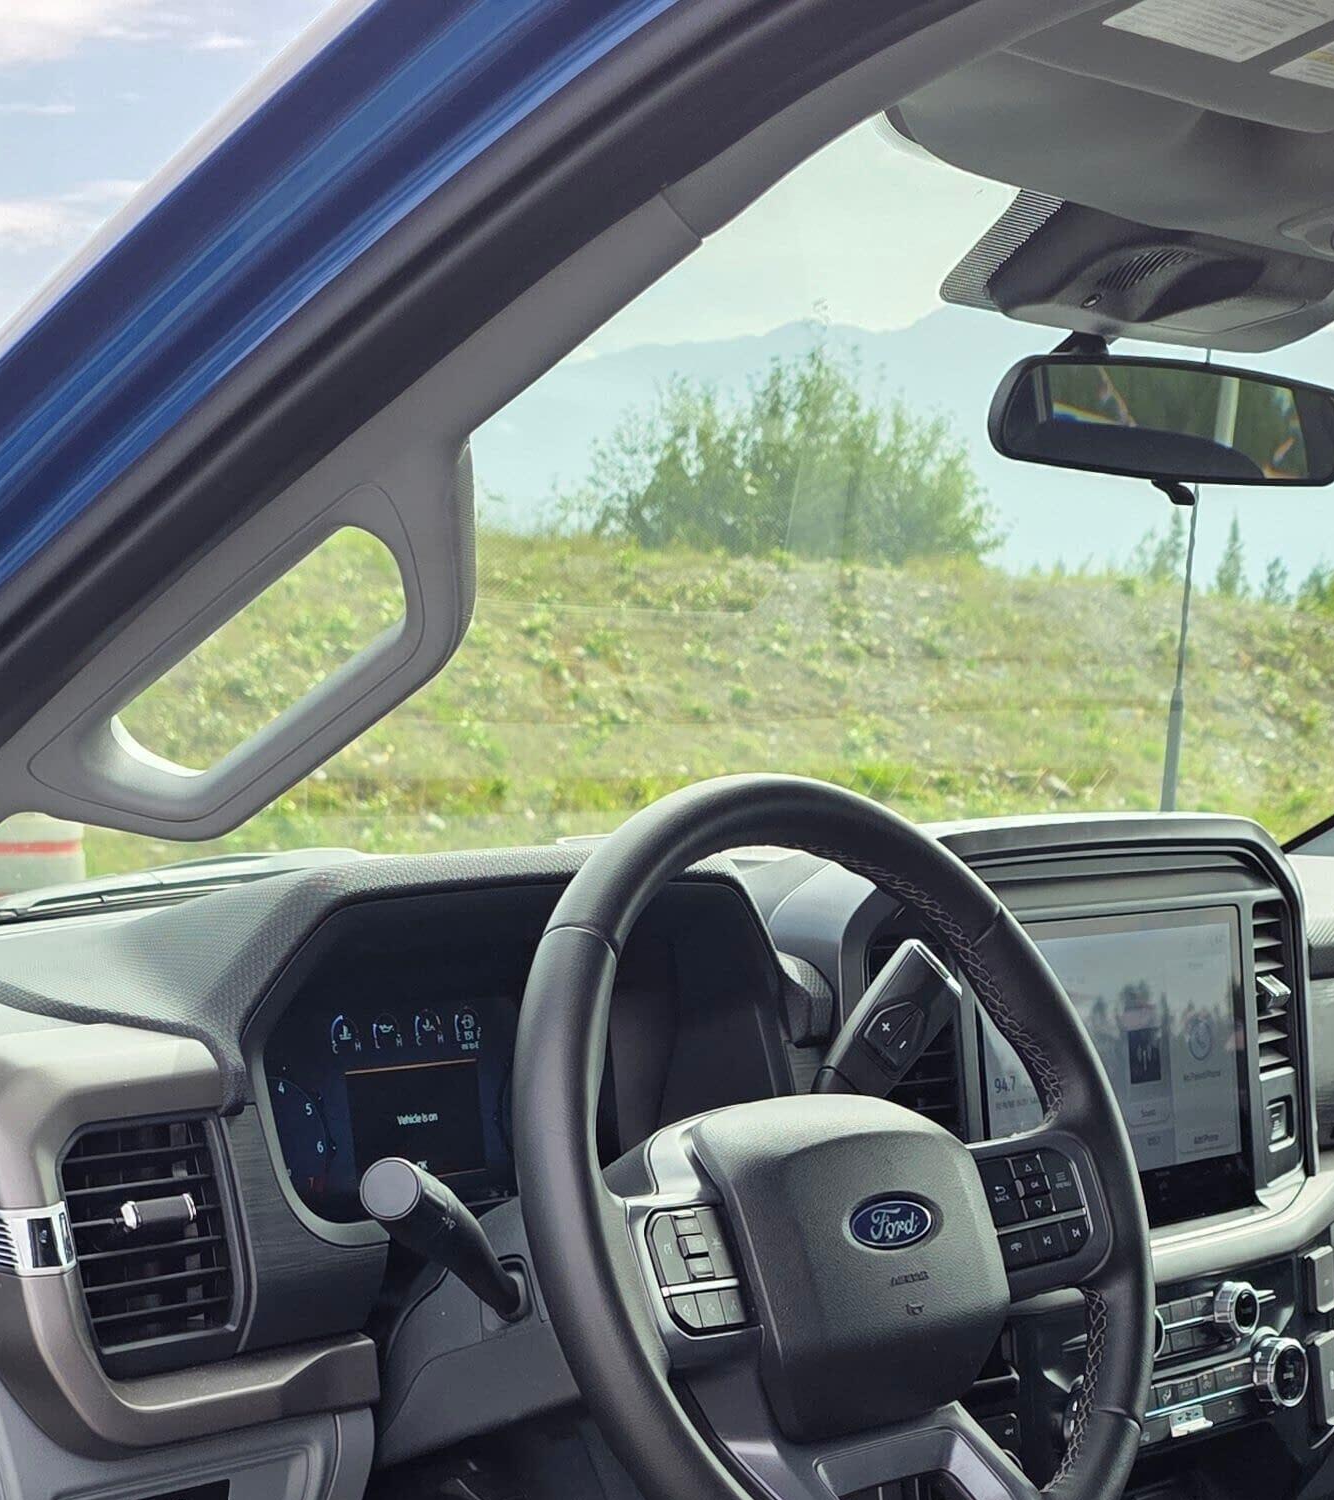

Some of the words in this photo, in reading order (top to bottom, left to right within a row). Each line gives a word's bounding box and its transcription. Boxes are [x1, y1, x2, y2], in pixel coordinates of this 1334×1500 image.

[278, 1082, 285, 1094] 4
[994, 1075, 1016, 1094] 94.7
[305, 1103, 313, 1115] 5
[397, 1113, 421, 1125] Vehicle
[428, 1113, 438, 1121] on
[317, 1141, 324, 1153] 6
[870, 1207, 921, 1241] Ford
